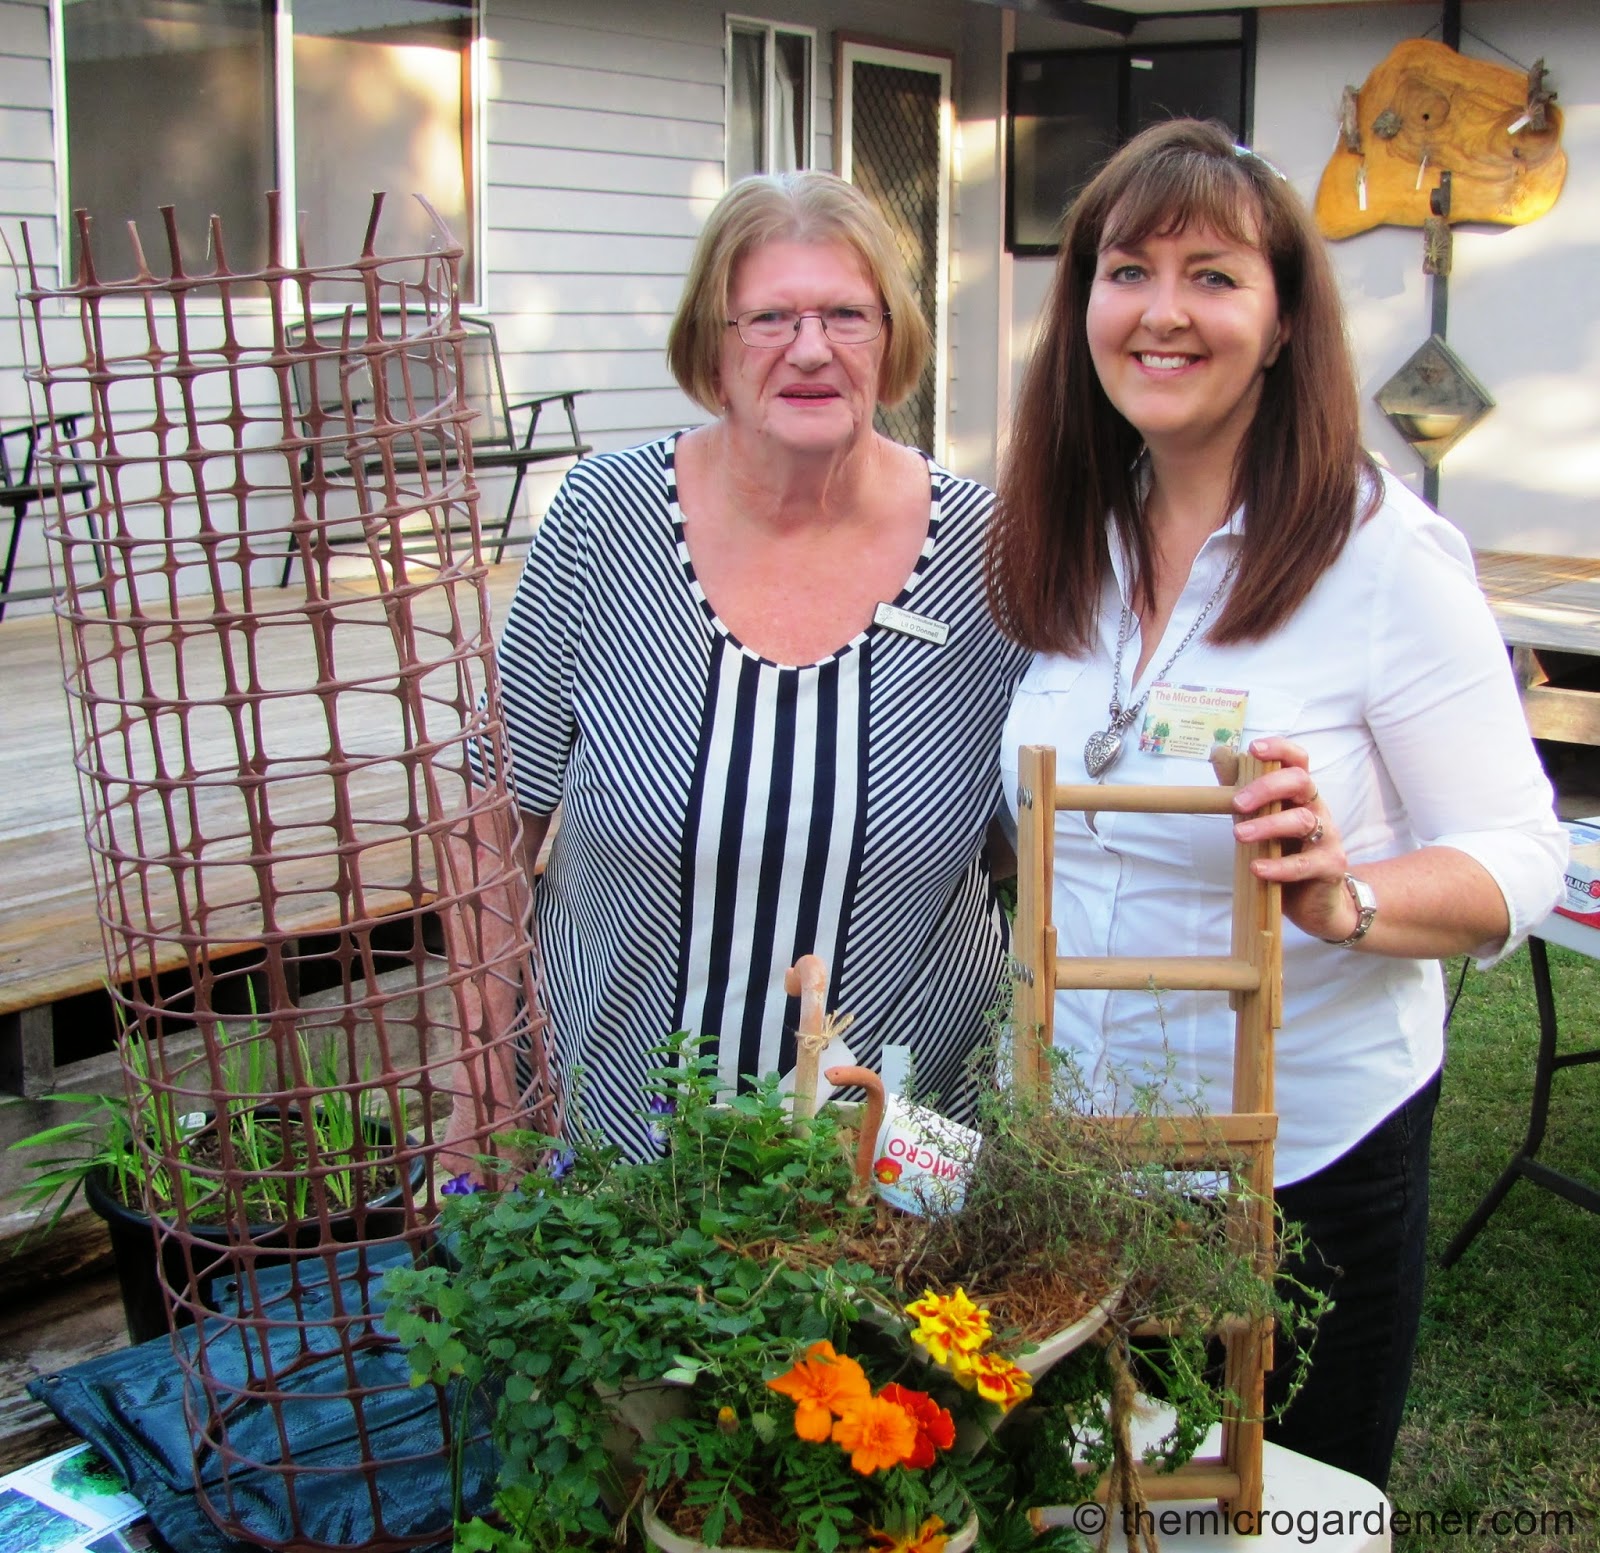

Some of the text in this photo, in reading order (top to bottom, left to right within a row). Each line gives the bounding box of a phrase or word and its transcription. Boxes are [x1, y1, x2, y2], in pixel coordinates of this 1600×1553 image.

[1155, 691, 1172, 701] The
[1172, 693, 1197, 704] Micro
[1199, 696, 1242, 709] Gardener
[888, 1138, 960, 1181] MICRO
